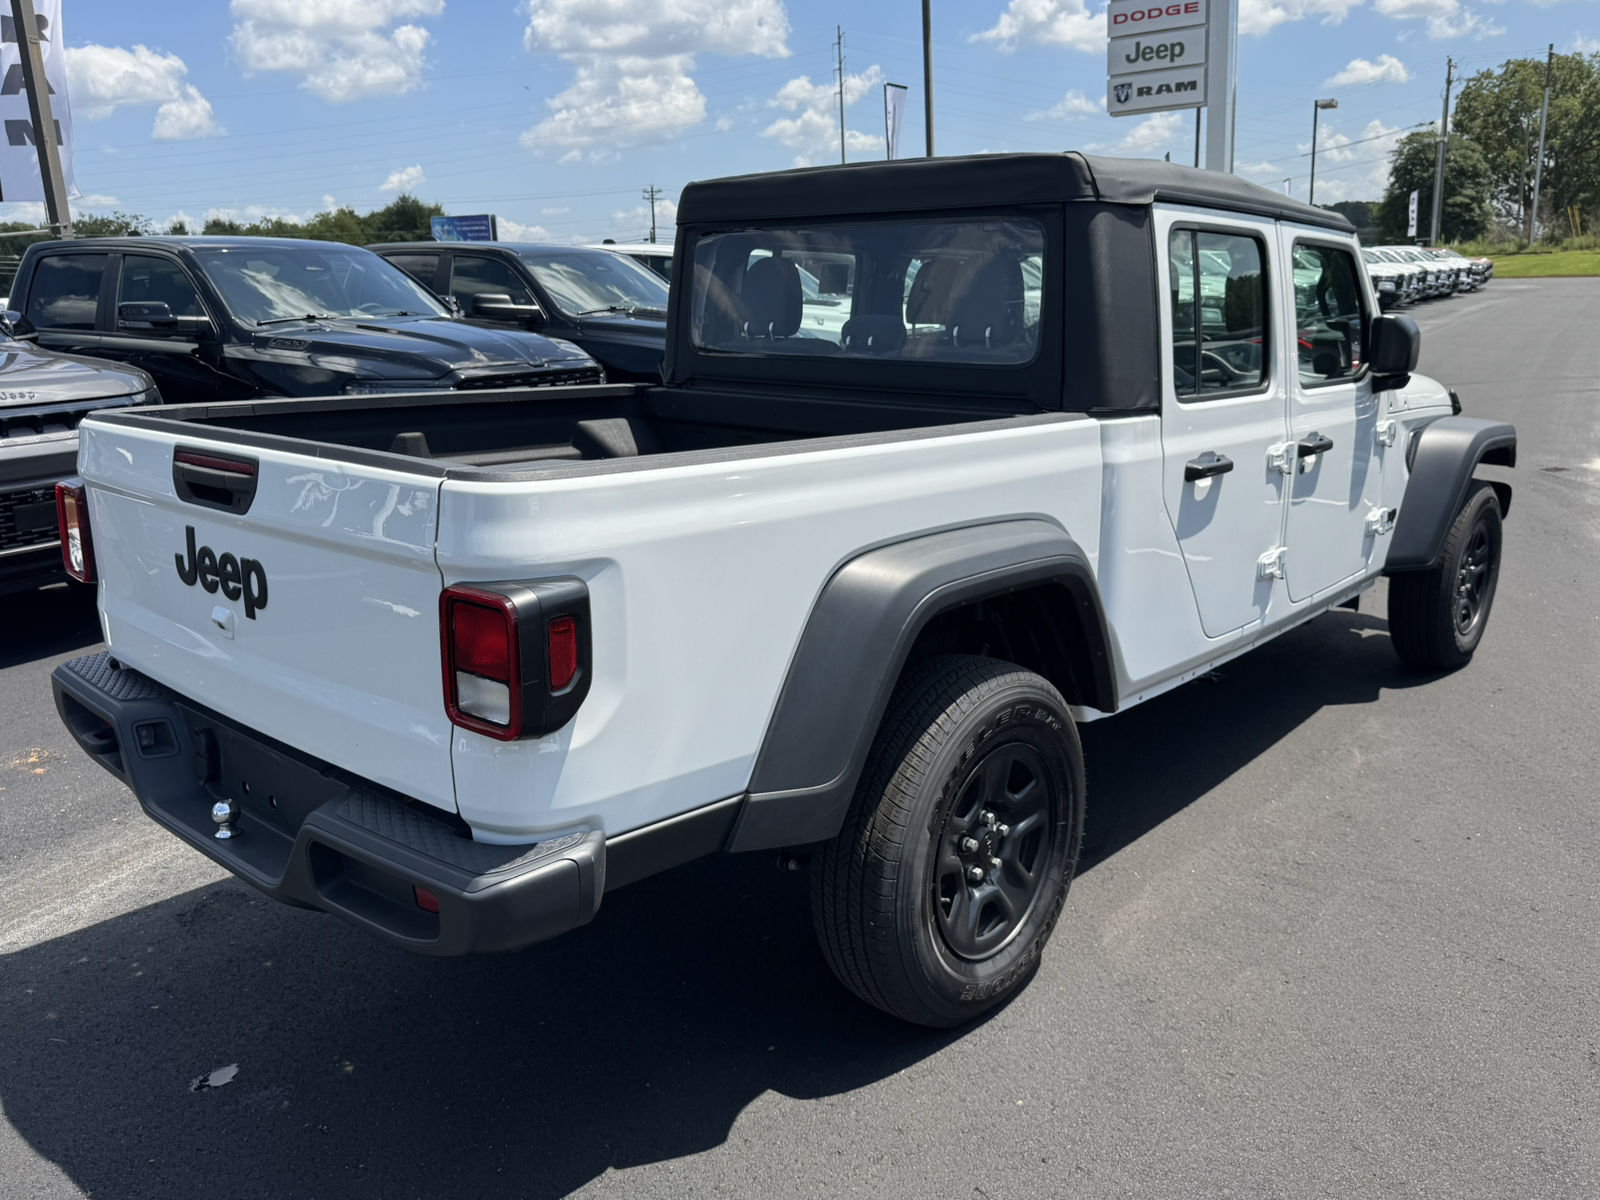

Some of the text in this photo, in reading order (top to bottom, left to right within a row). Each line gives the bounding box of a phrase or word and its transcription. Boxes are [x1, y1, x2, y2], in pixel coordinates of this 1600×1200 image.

[1113, 1, 1199, 25] DODGE
[1125, 41, 1185, 64] Jeep
[1136, 80, 1197, 97] RAM
[0, 391, 35, 400] Jeep
[174, 524, 268, 620] Jeep
